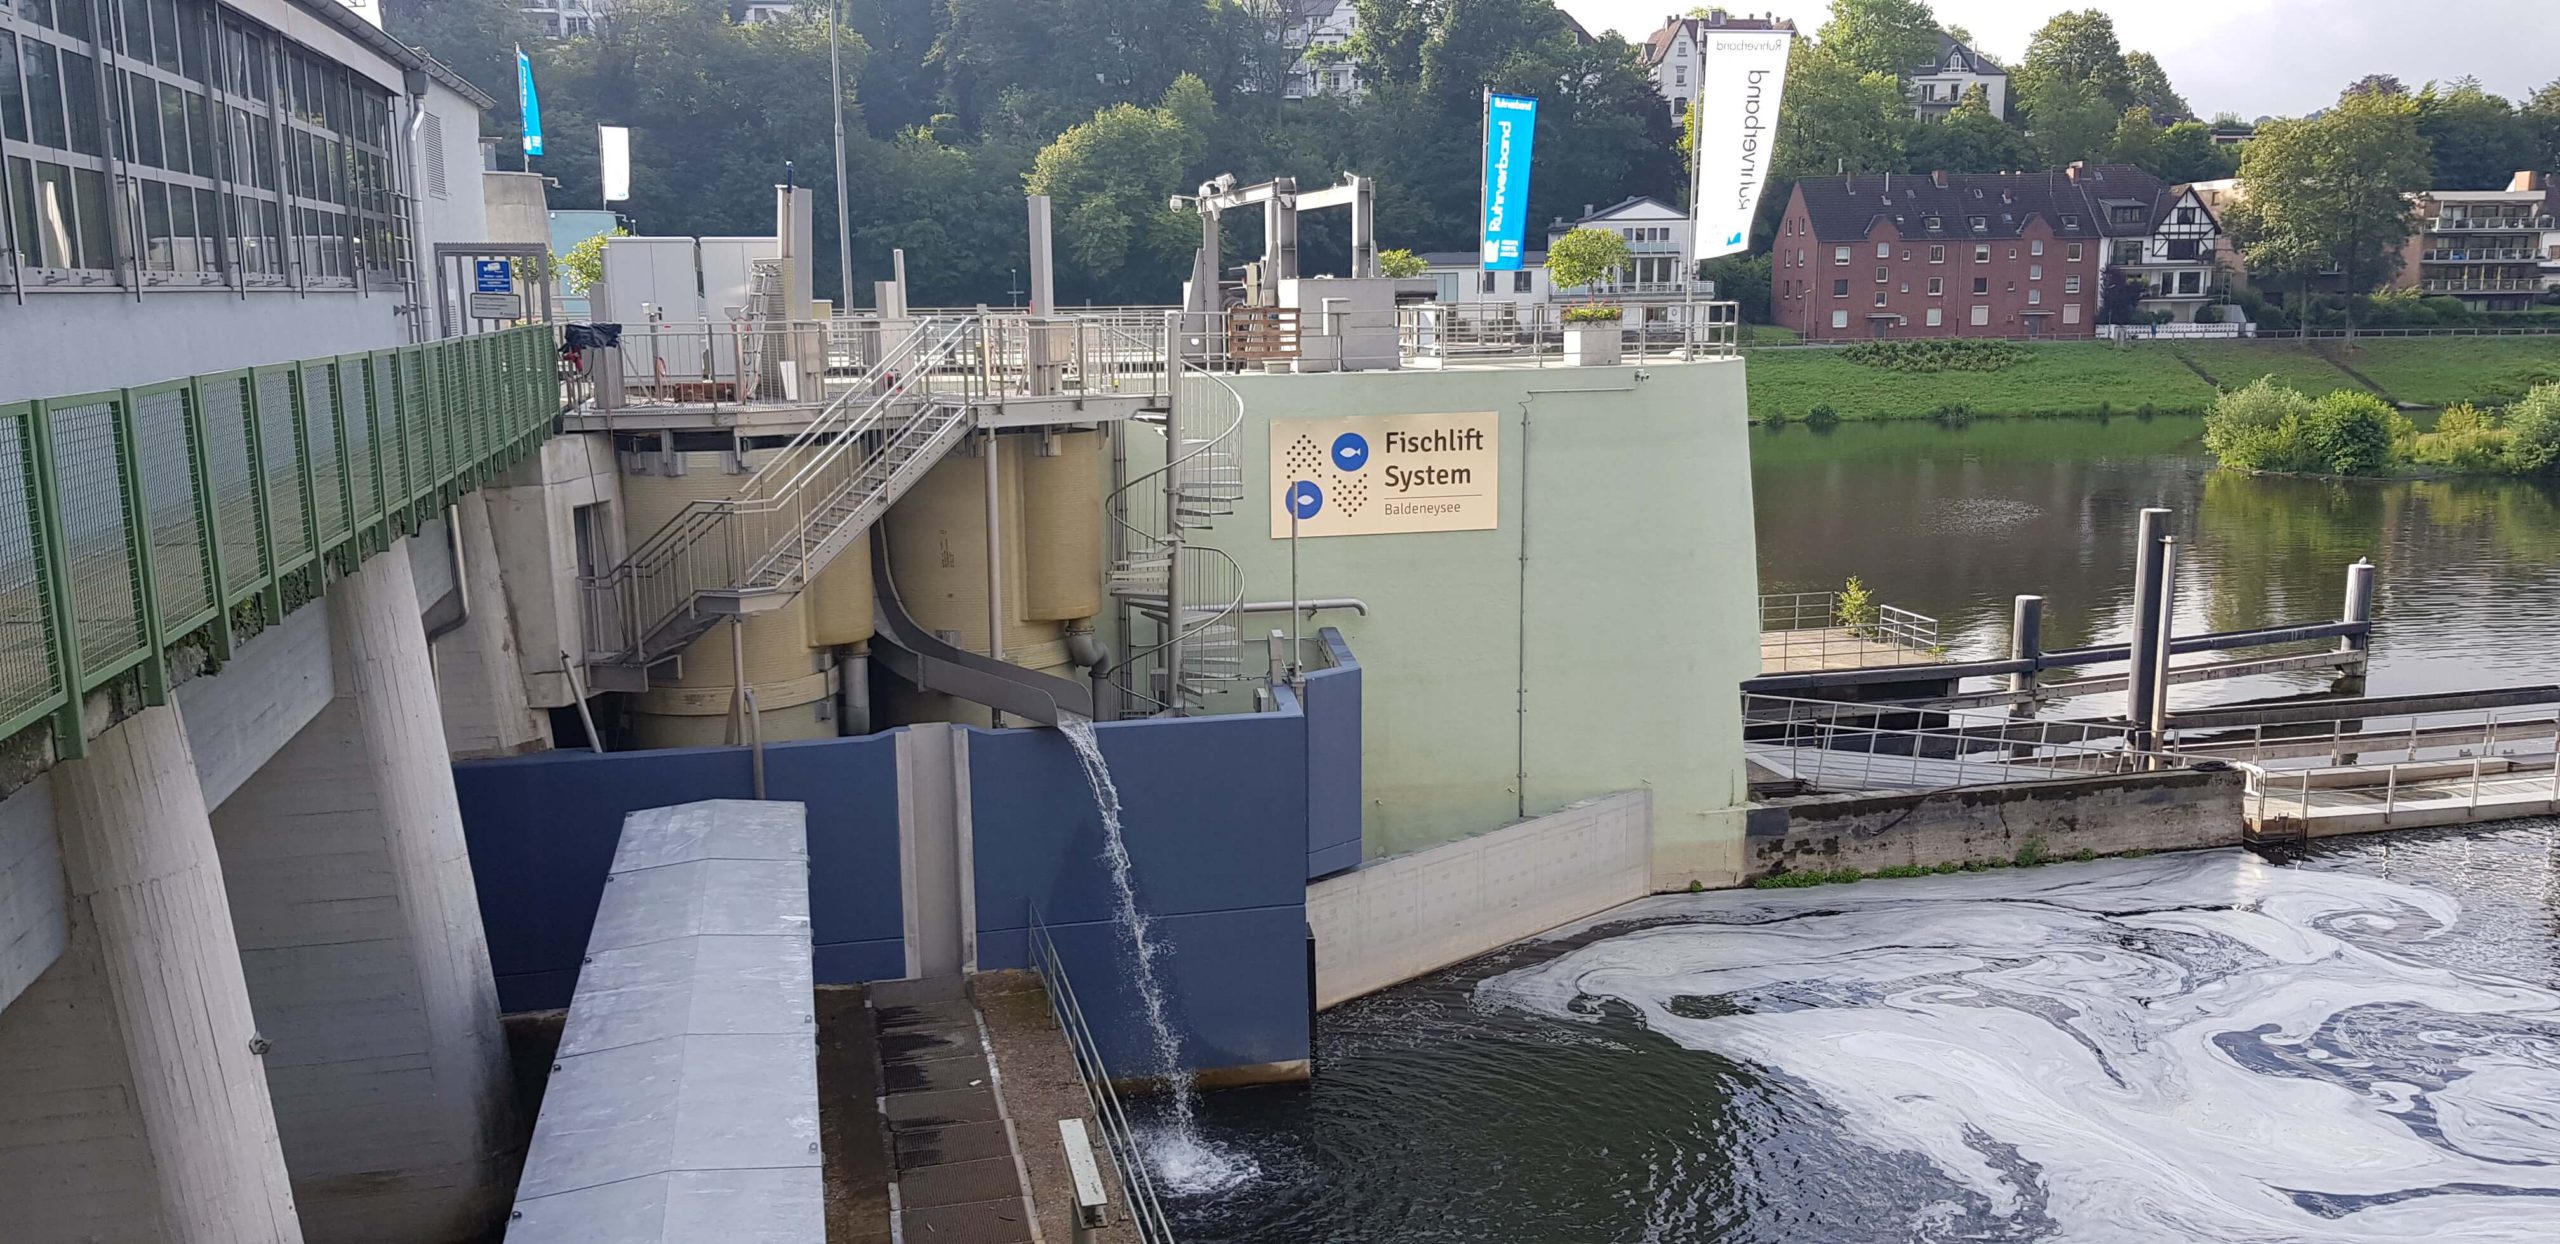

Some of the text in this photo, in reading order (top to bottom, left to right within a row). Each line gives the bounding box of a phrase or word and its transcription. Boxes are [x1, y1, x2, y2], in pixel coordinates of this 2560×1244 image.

[1488, 121, 1512, 232] Ruhrverband
[1386, 428, 1484, 453] Fischlift
[1384, 465, 1471, 492] System
[1384, 502, 1461, 516] Baldeneysee
